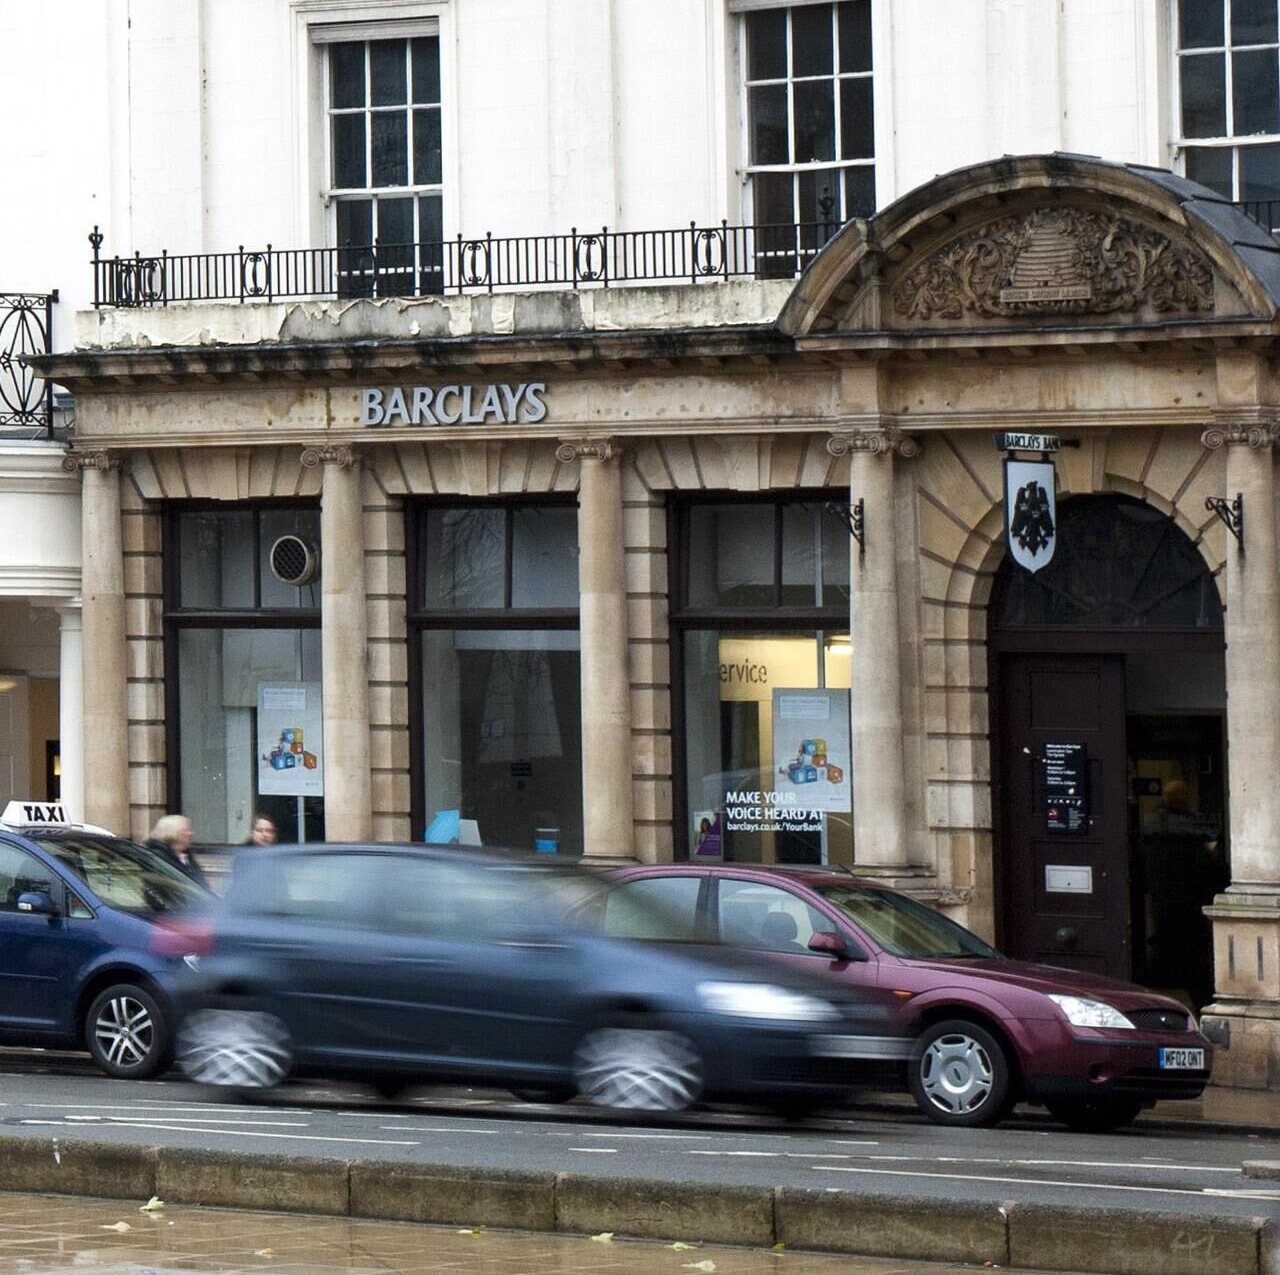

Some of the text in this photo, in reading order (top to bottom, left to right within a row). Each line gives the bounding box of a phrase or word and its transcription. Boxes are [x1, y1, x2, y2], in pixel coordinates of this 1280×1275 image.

[361, 382, 547, 426] BARCLAYS
[1007, 435, 1040, 449] BARCLAYS
[720, 660, 768, 684] ervice
[726, 791, 797, 804] MAKE YOUR
[23, 805, 65, 822] TAXI
[726, 807, 824, 820] VOICE HEARD AT
[727, 821, 824, 833] barclays.co.uk/YourBank
